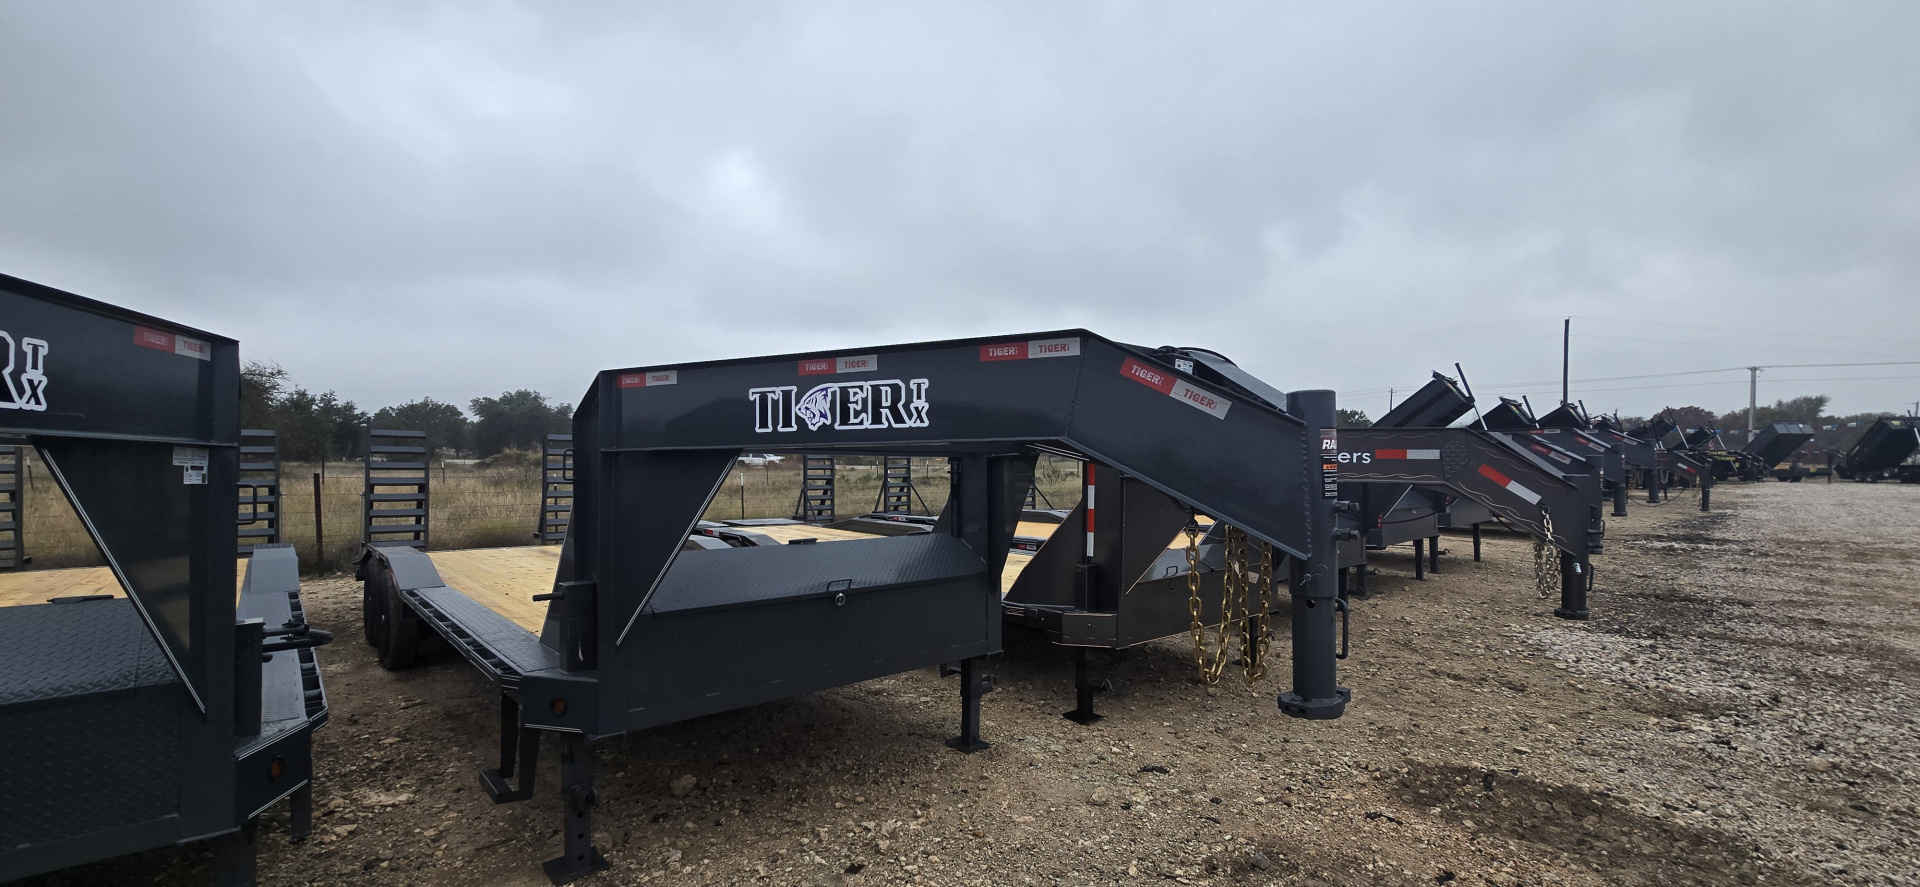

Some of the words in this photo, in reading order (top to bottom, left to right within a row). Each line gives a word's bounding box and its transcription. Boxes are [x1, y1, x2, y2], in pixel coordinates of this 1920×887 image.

[988, 346, 1015, 356] TIGER
[1039, 343, 1066, 354] TIGER
[804, 362, 826, 371] TIGER
[844, 360, 866, 369] TIGER
[1131, 365, 1161, 385] TIGER
[1183, 388, 1215, 410] TIGER
[1337, 452, 1371, 464] ers
